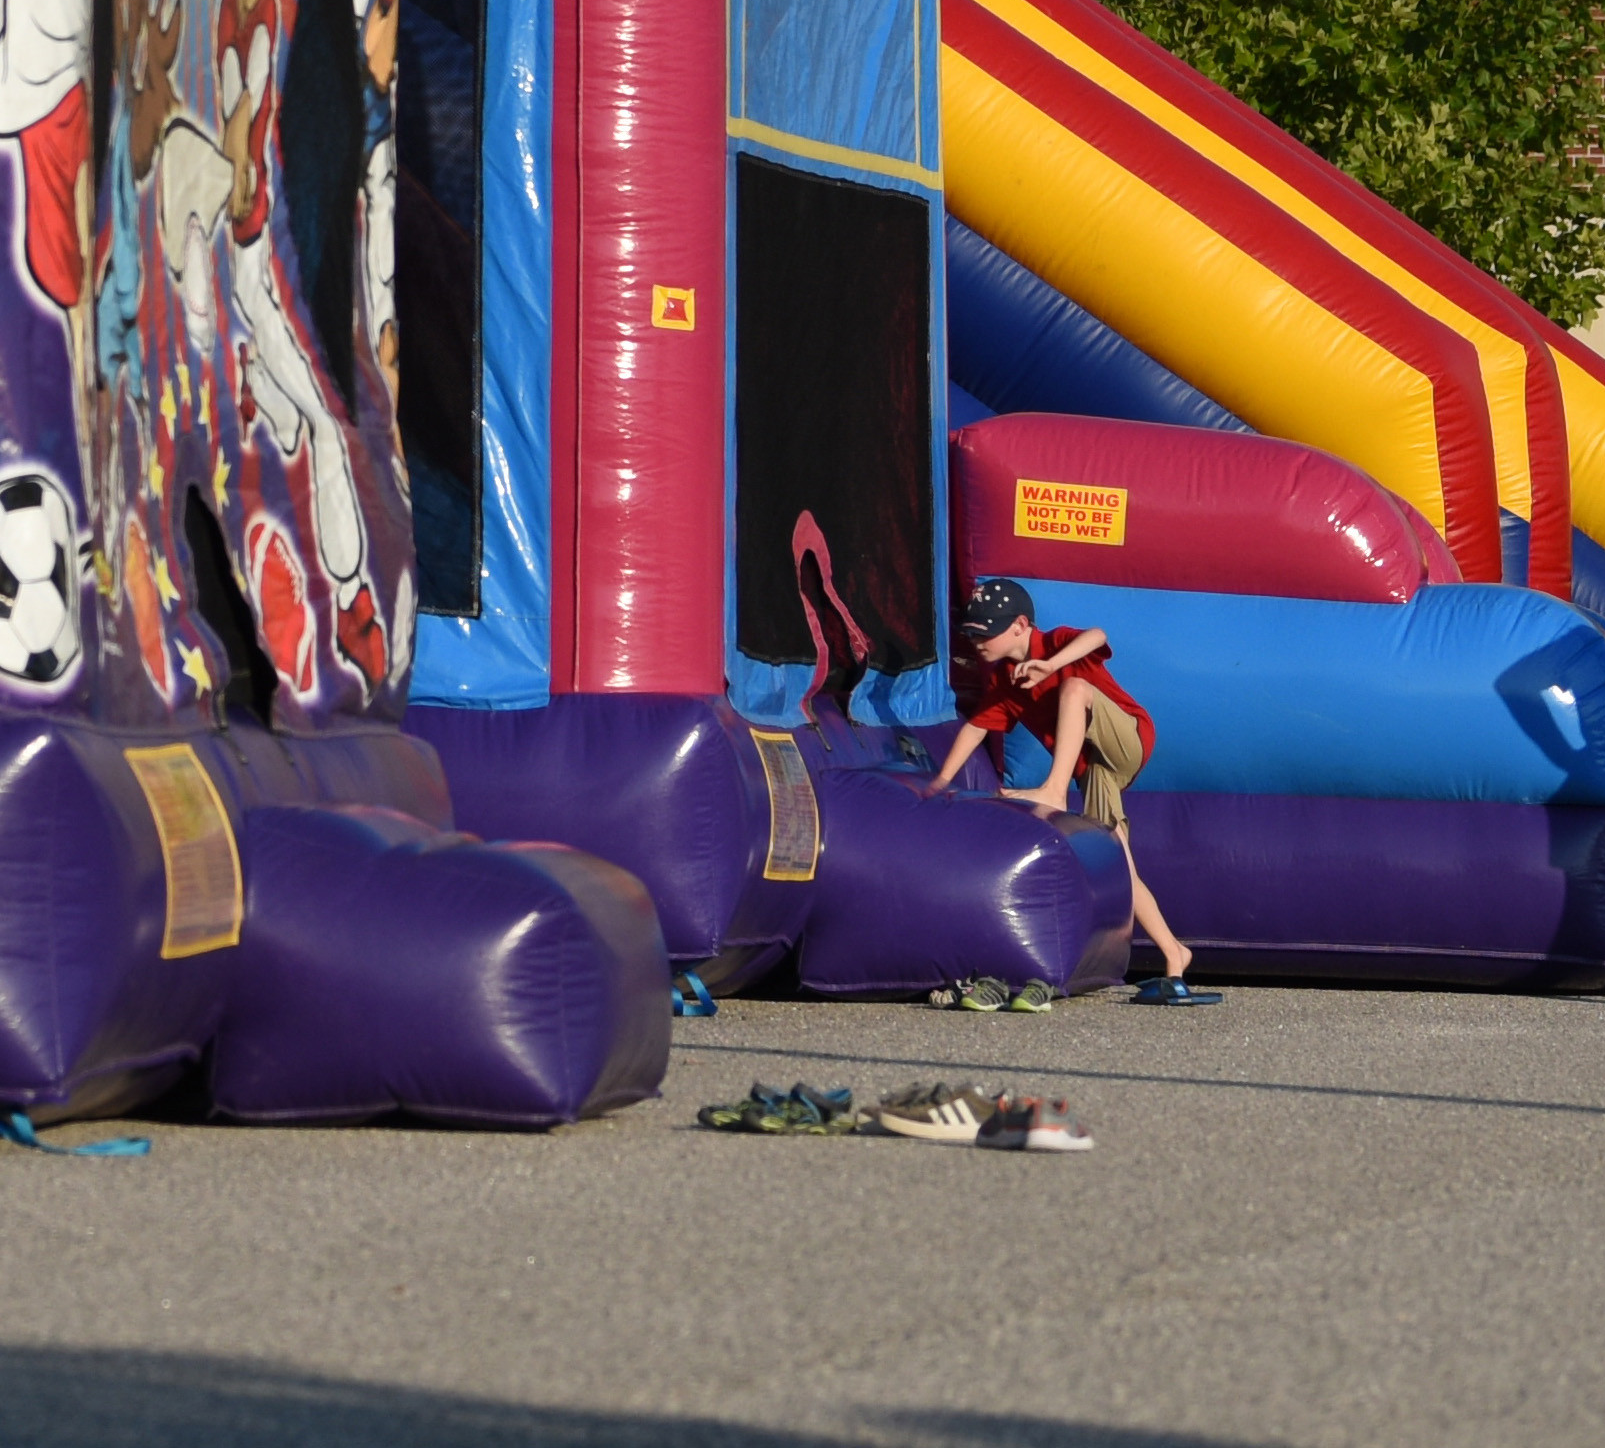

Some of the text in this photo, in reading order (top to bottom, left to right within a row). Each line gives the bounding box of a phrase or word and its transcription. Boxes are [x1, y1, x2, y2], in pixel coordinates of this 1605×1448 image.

[1022, 486, 1120, 508] WARNING
[1027, 506, 1113, 524] NOT TO BE
[1027, 520, 1111, 538] USED WET
